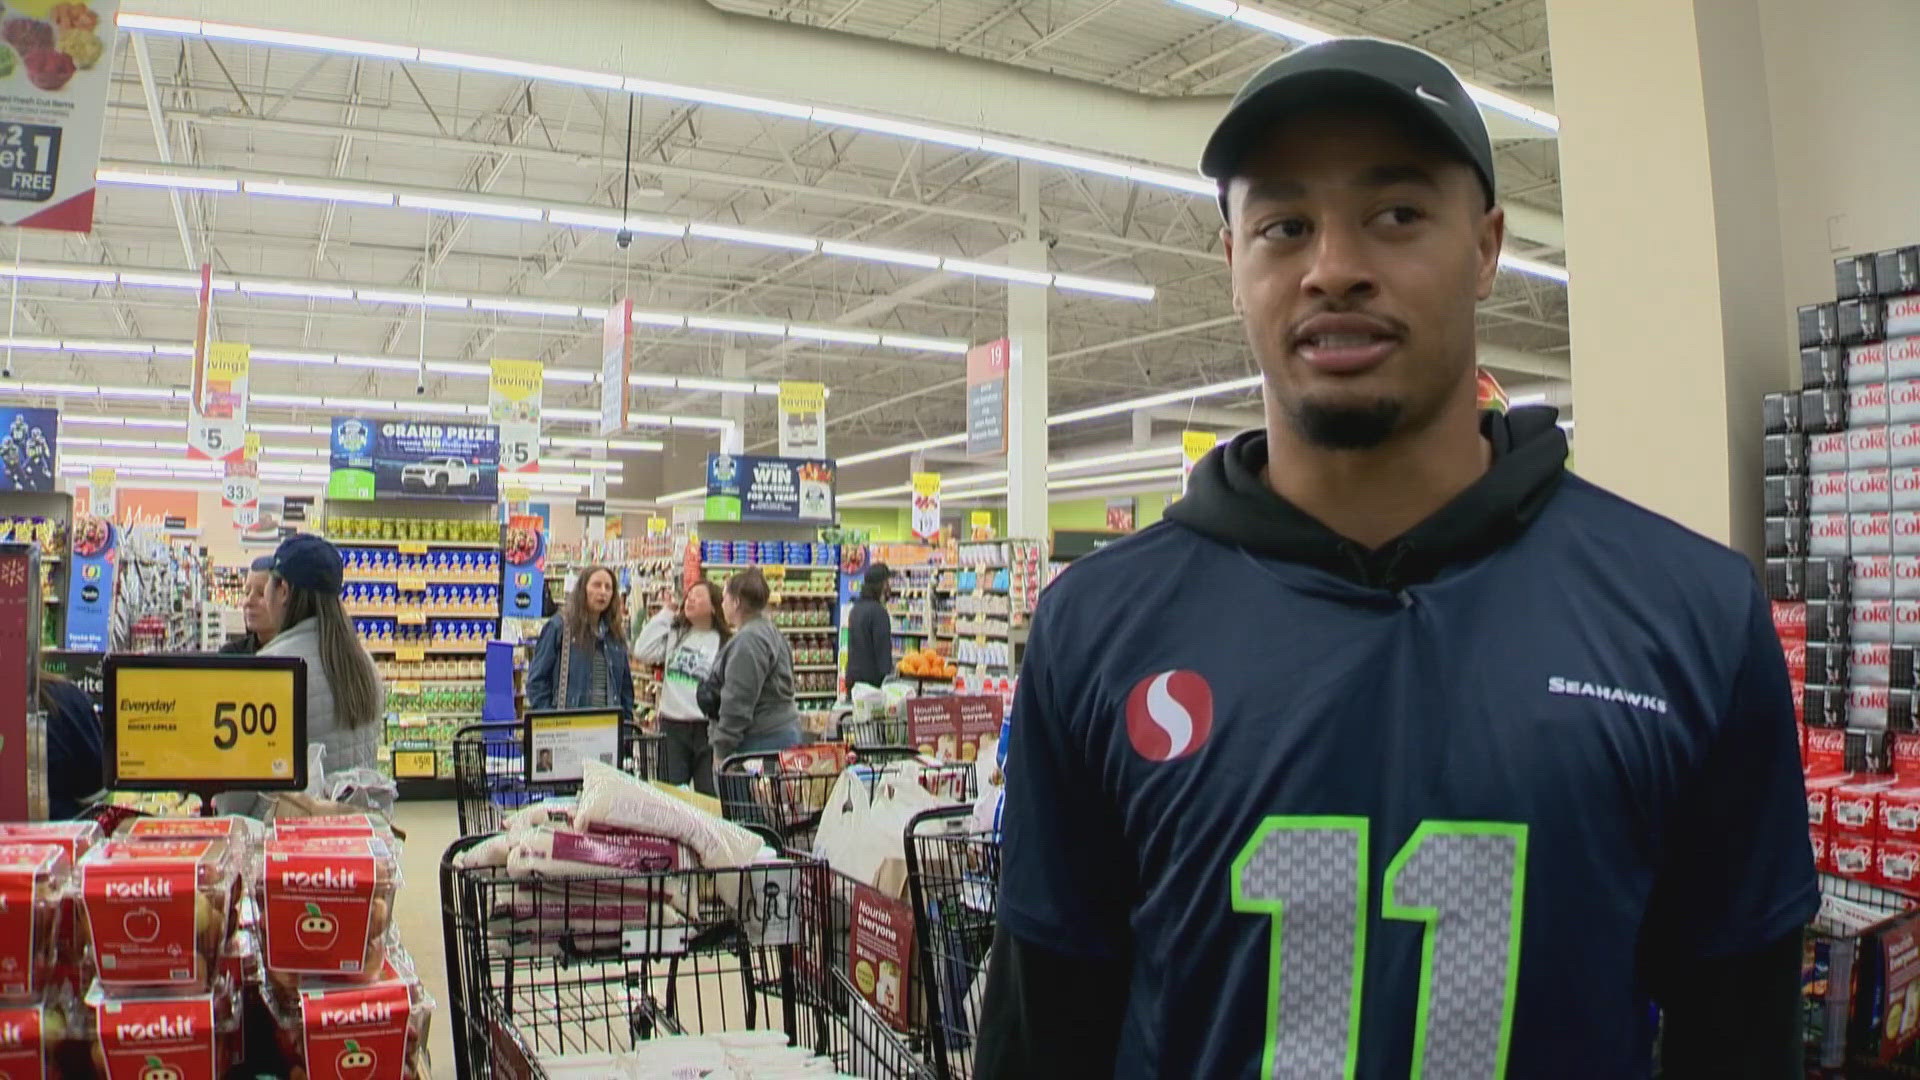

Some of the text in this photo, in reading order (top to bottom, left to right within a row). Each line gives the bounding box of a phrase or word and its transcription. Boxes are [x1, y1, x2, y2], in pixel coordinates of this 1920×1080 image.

[7, 125, 23, 145] 2
[0, 147, 26, 169] et
[34, 135, 52, 172] 1
[11, 172, 53, 191] FREE
[989, 346, 1002, 367] 19
[1848, 388, 1885, 409] Coke
[382, 423, 495, 441] GRAND PRIZE
[1850, 433, 1885, 452] Coke
[753, 468, 791, 483] WIN
[1850, 475, 1889, 493] Coke
[747, 492, 763, 501] FOR
[765, 493, 772, 501] A
[751, 484, 794, 493] GROCERIES
[1810, 477, 1847, 497] Coke
[1810, 519, 1847, 537] Coke
[1851, 517, 1890, 537] Coke
[1853, 560, 1891, 580] Coke
[1852, 605, 1891, 623] Coke
[1851, 647, 1890, 666] Coke
[44, 661, 66, 673] fruit
[1548, 676, 1667, 714] SEAHAWKS
[1850, 691, 1889, 709] Coke
[120, 699, 176, 715] Everyday!
[914, 704, 944, 715] Nourish
[914, 712, 951, 723] Everyone
[962, 712, 993, 722] veryone
[859, 900, 892, 926] Nourish
[857, 913, 897, 942] Everyone
[1231, 815, 1529, 1080] 11
